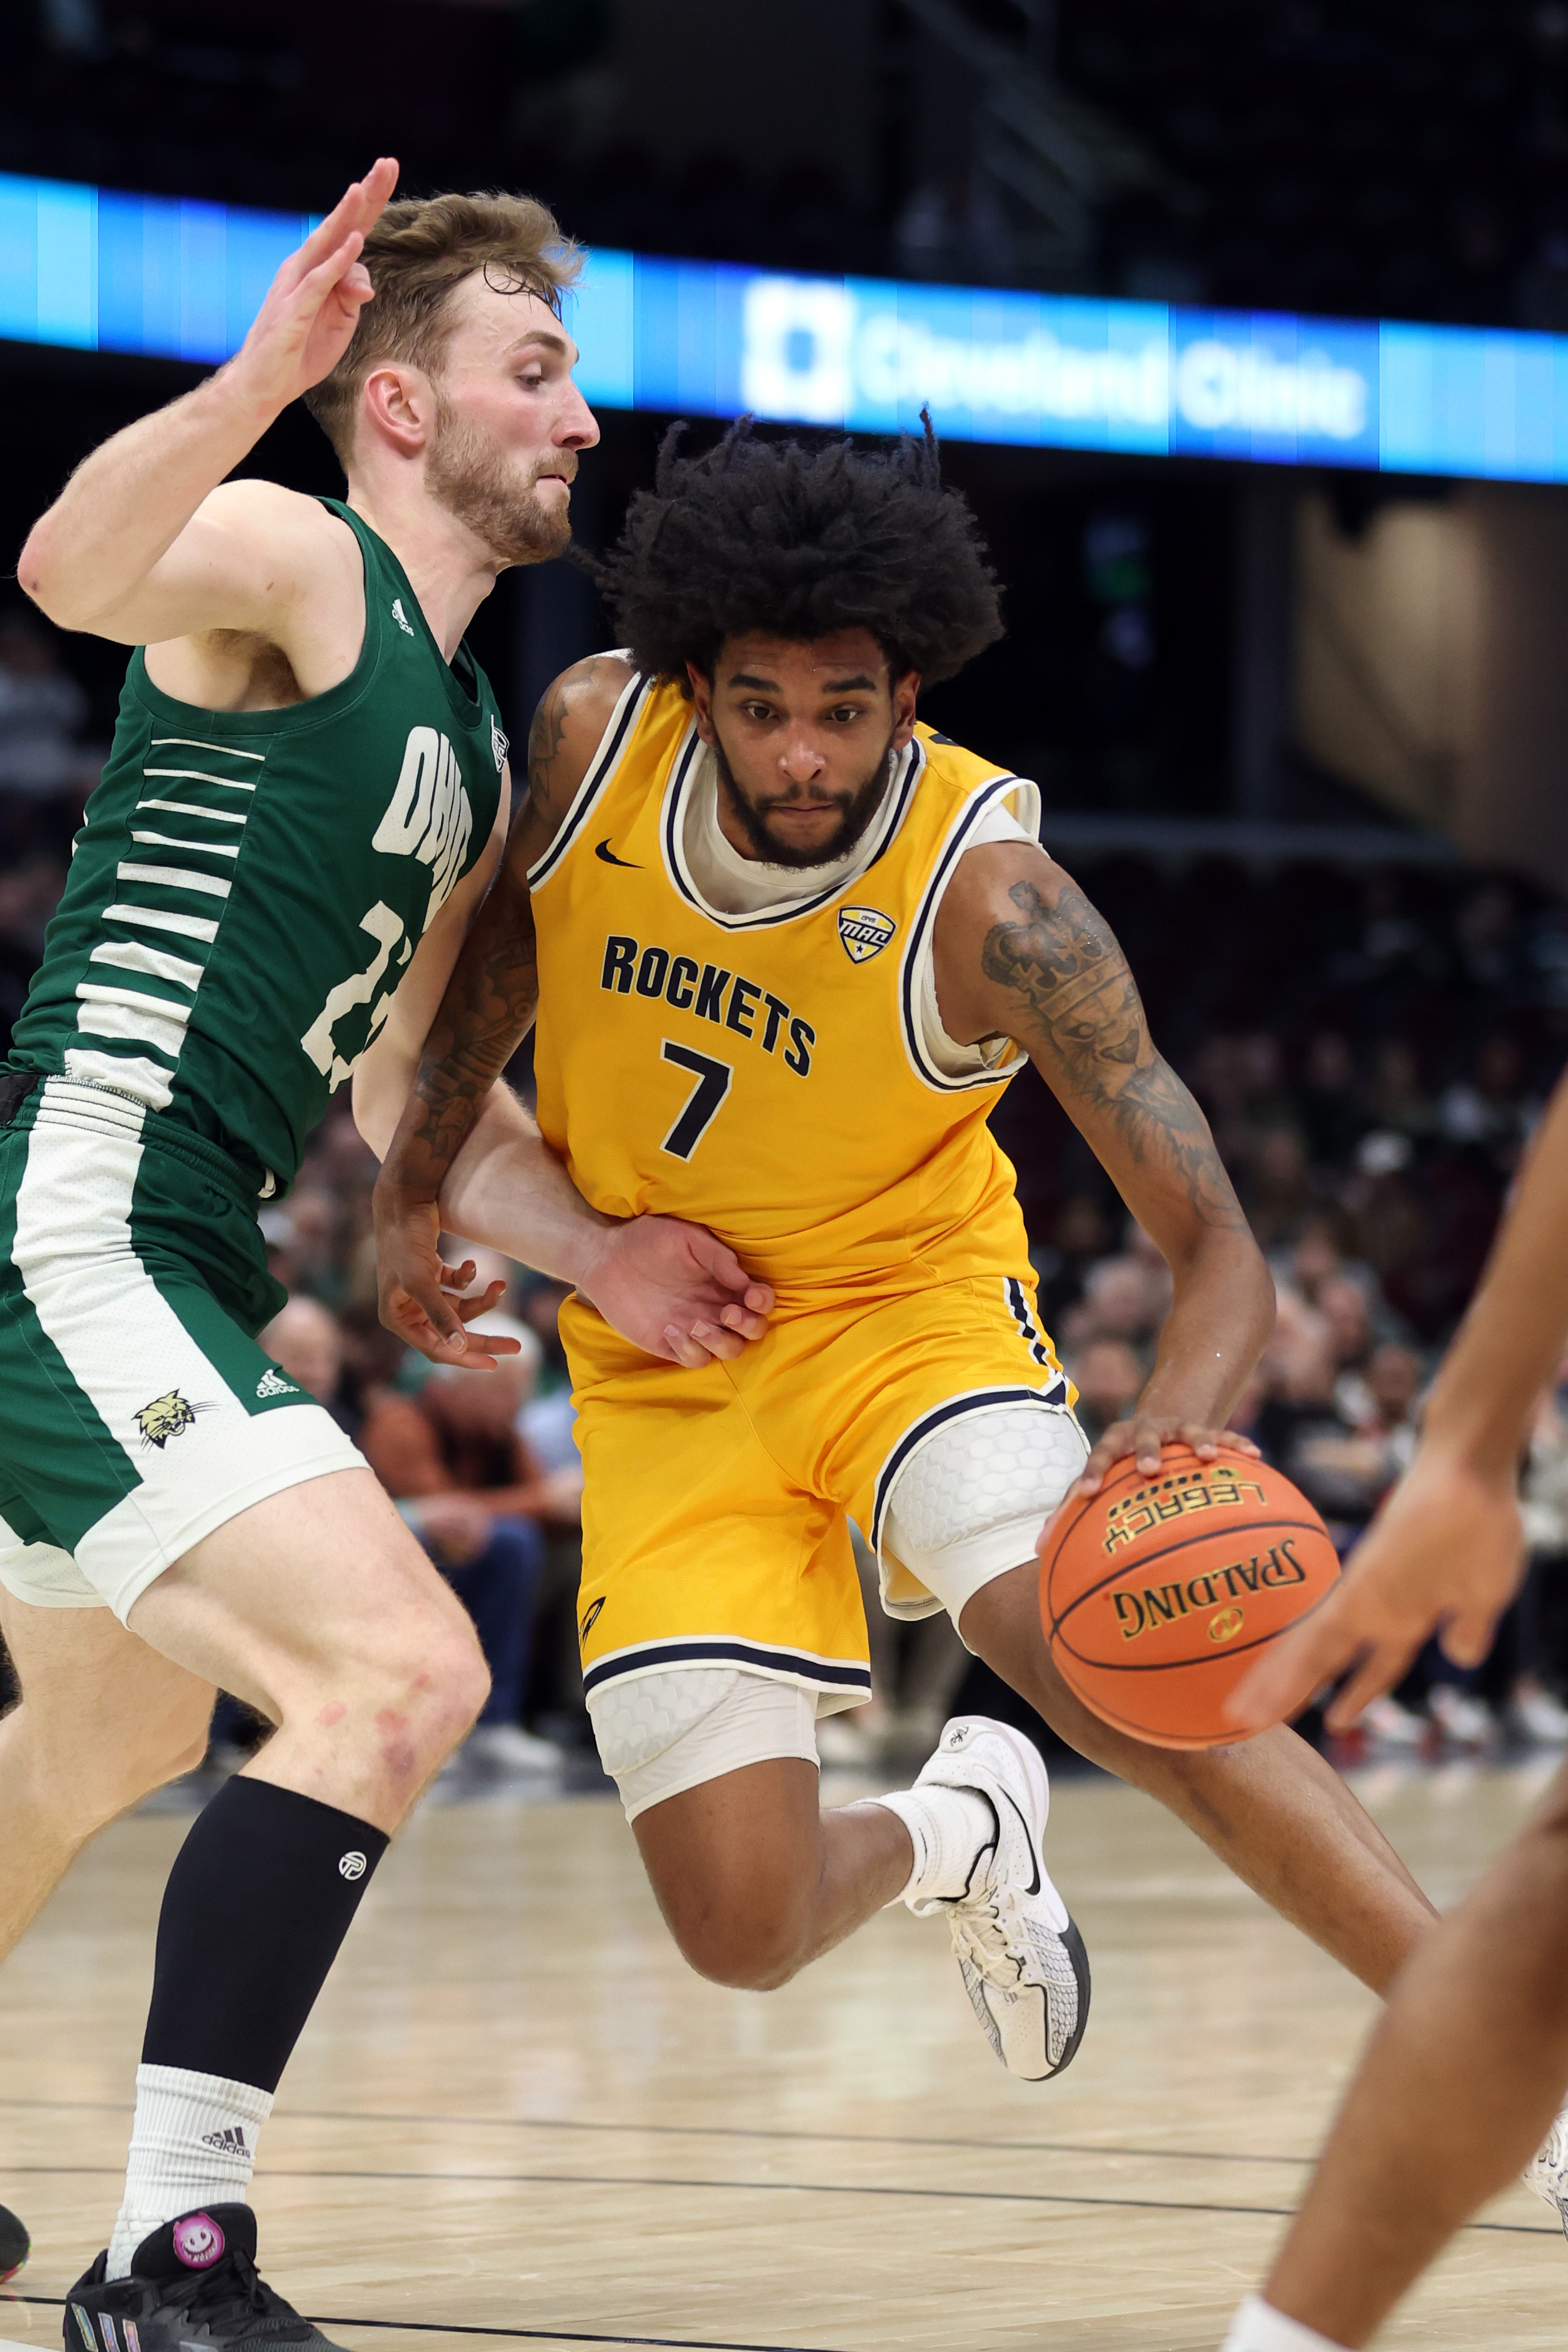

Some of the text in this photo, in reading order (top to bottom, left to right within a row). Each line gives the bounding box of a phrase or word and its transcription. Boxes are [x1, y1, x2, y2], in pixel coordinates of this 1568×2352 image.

[840, 920, 889, 946] MAC
[600, 934, 816, 1078] ROCKETS
[659, 1037, 734, 1163] 7
[1102, 1482, 1268, 1554] LEGACY
[1112, 1538, 1307, 1642] SPALDING
[202, 2135, 250, 2159] adidas
